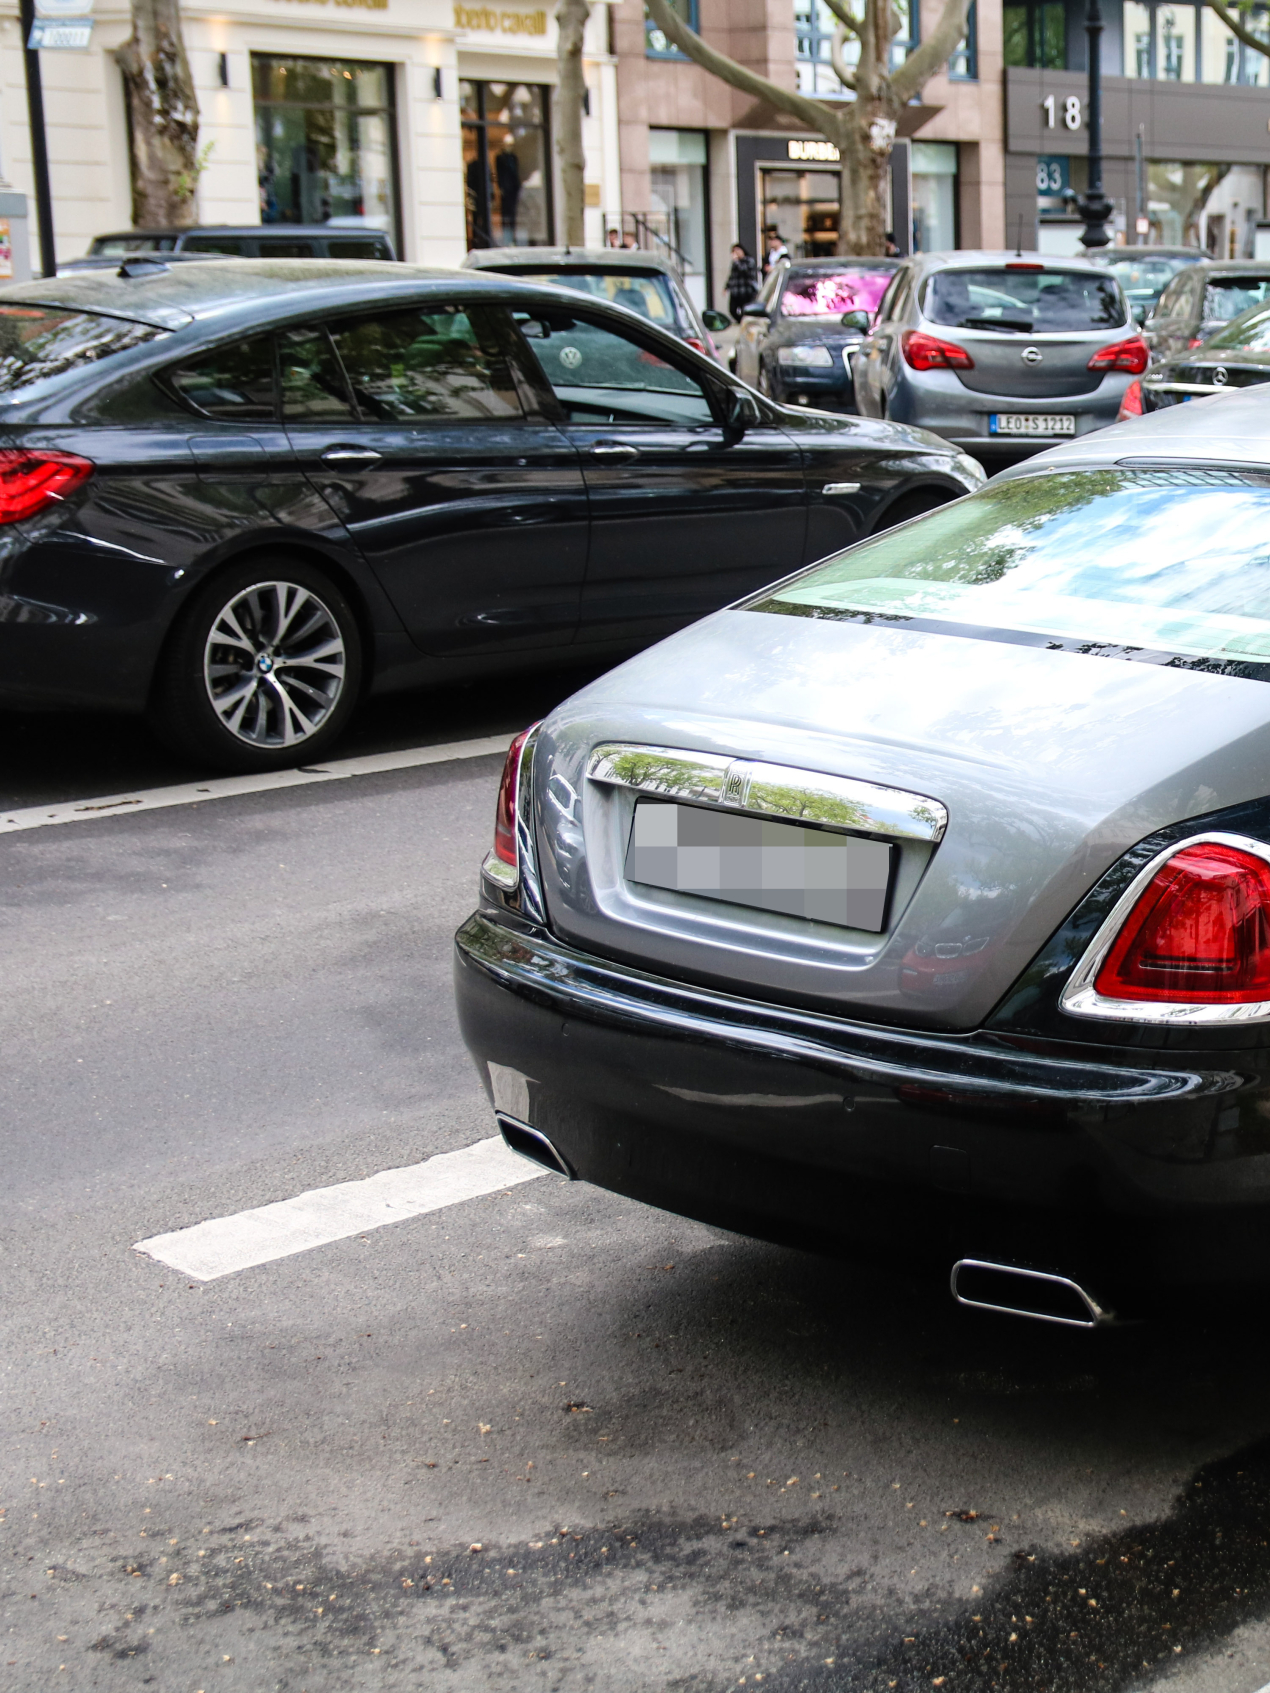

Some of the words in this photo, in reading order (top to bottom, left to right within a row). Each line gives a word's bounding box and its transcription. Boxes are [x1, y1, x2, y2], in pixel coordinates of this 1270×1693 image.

[1043, 94, 1081, 130] 18
[999, 415, 1022, 430] LEO
[1043, 416, 1073, 431] 1212
